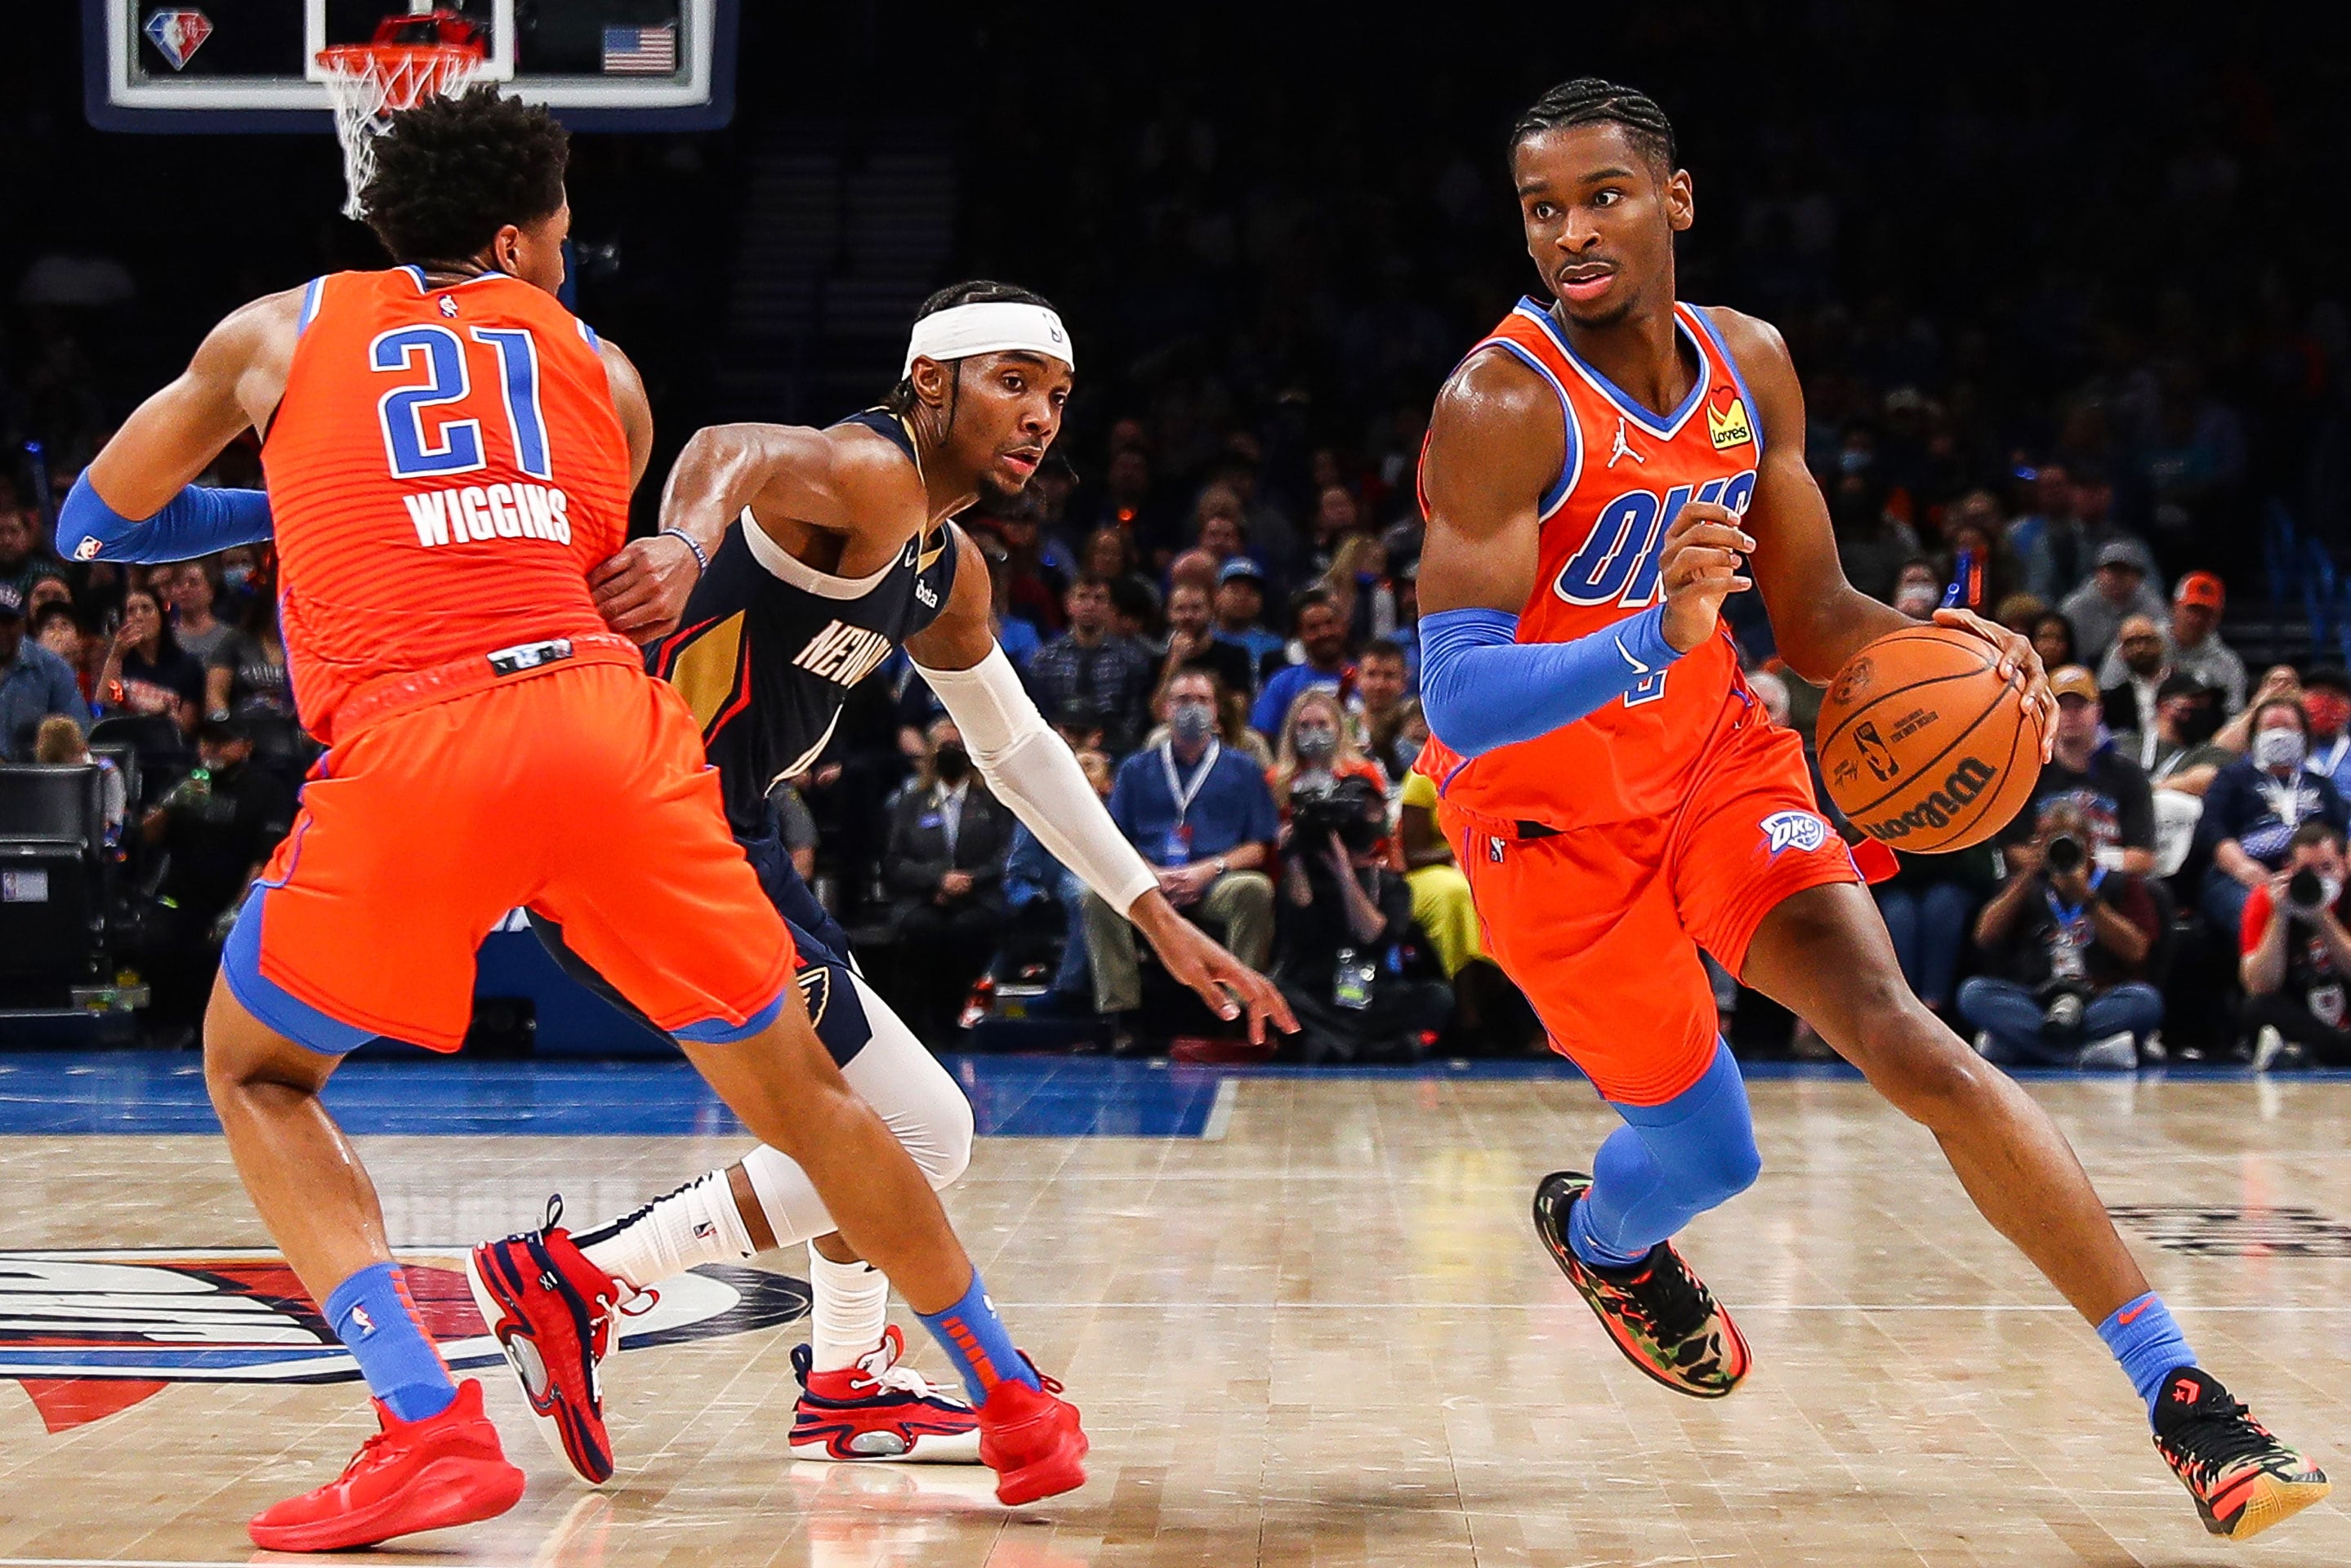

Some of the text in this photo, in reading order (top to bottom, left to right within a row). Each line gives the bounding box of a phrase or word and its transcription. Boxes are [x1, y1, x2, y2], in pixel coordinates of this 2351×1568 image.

[369, 324, 553, 481] 21
[402, 483, 571, 546] WIGGINS
[1863, 756, 1998, 840] Wilson
[1771, 818, 1815, 852] OKC
